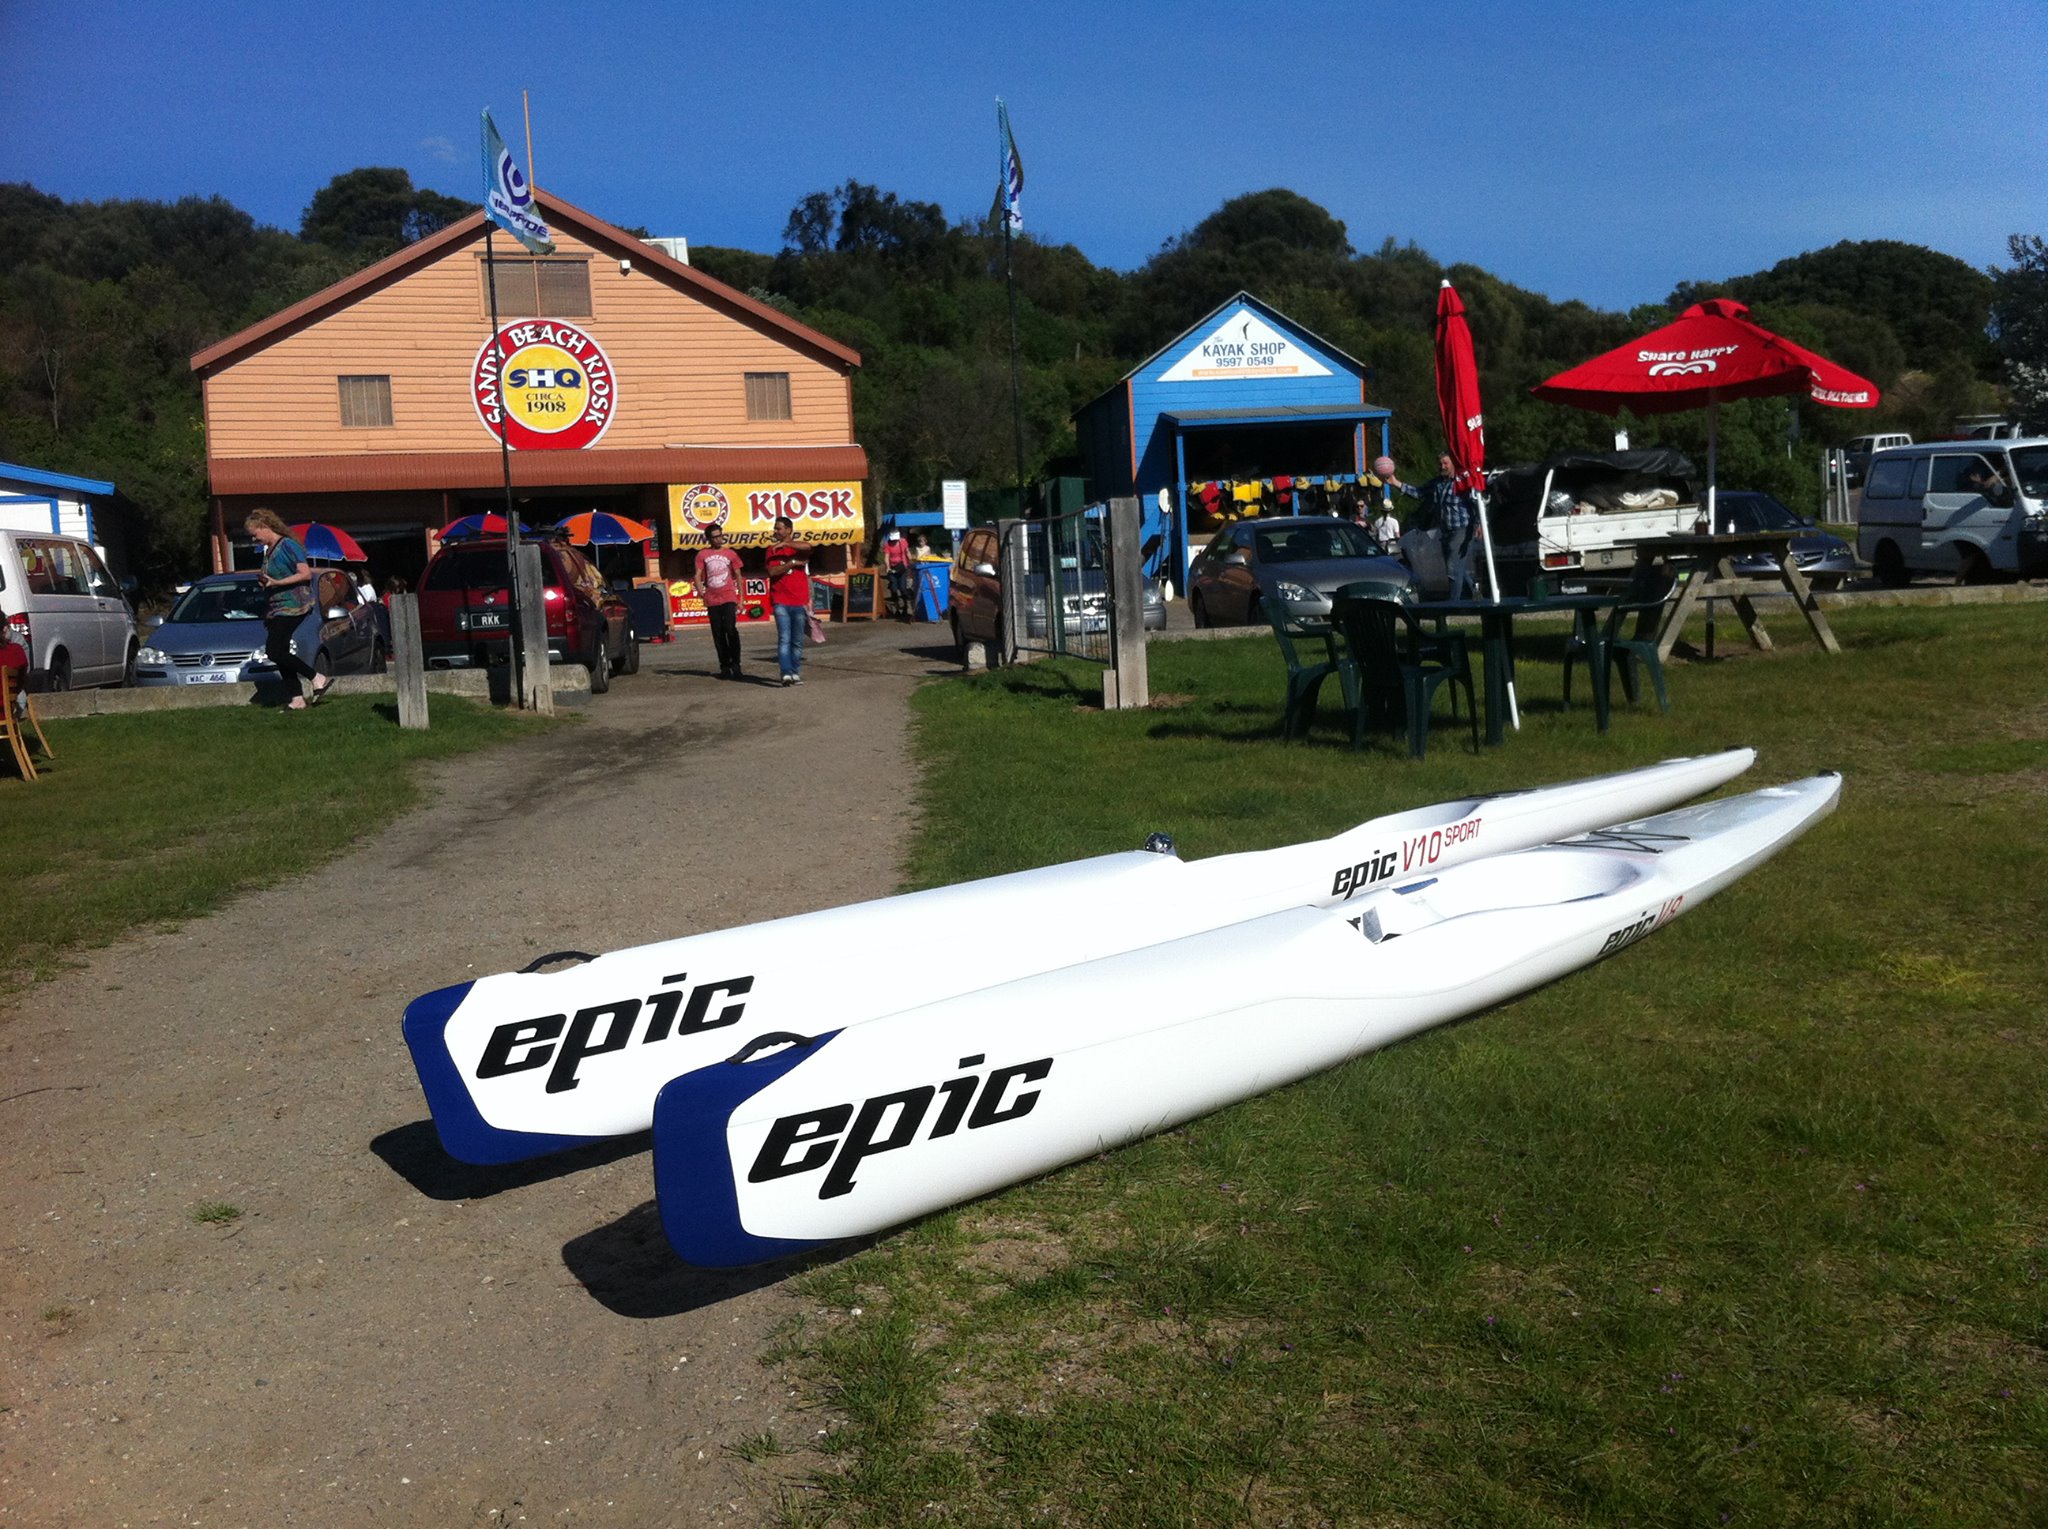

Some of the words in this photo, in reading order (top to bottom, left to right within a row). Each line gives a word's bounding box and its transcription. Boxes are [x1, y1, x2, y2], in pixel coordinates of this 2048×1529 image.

[1202, 343, 1245, 357] KAYAK
[1250, 342, 1286, 355] SHOP
[1215, 358, 1243, 368] 9597
[1246, 356, 1274, 366] 0549
[478, 345, 506, 424] SANDY
[508, 324, 587, 354] BEACH
[583, 354, 610, 427] KIOSK
[507, 368, 582, 389] SHQ
[525, 392, 564, 401] CIRCA
[526, 401, 567, 413] 1908
[748, 490, 854, 523] KIOSK
[803, 530, 854, 542] School
[746, 580, 766, 595] HQ
[481, 615, 500, 626] RKK
[189, 675, 205, 683] WAC
[1331, 849, 1398, 901] epic
[1402, 830, 1442, 872] V10
[1444, 818, 1482, 847] SPORT
[475, 972, 755, 1094] epic
[747, 1053, 1054, 1200] epic
